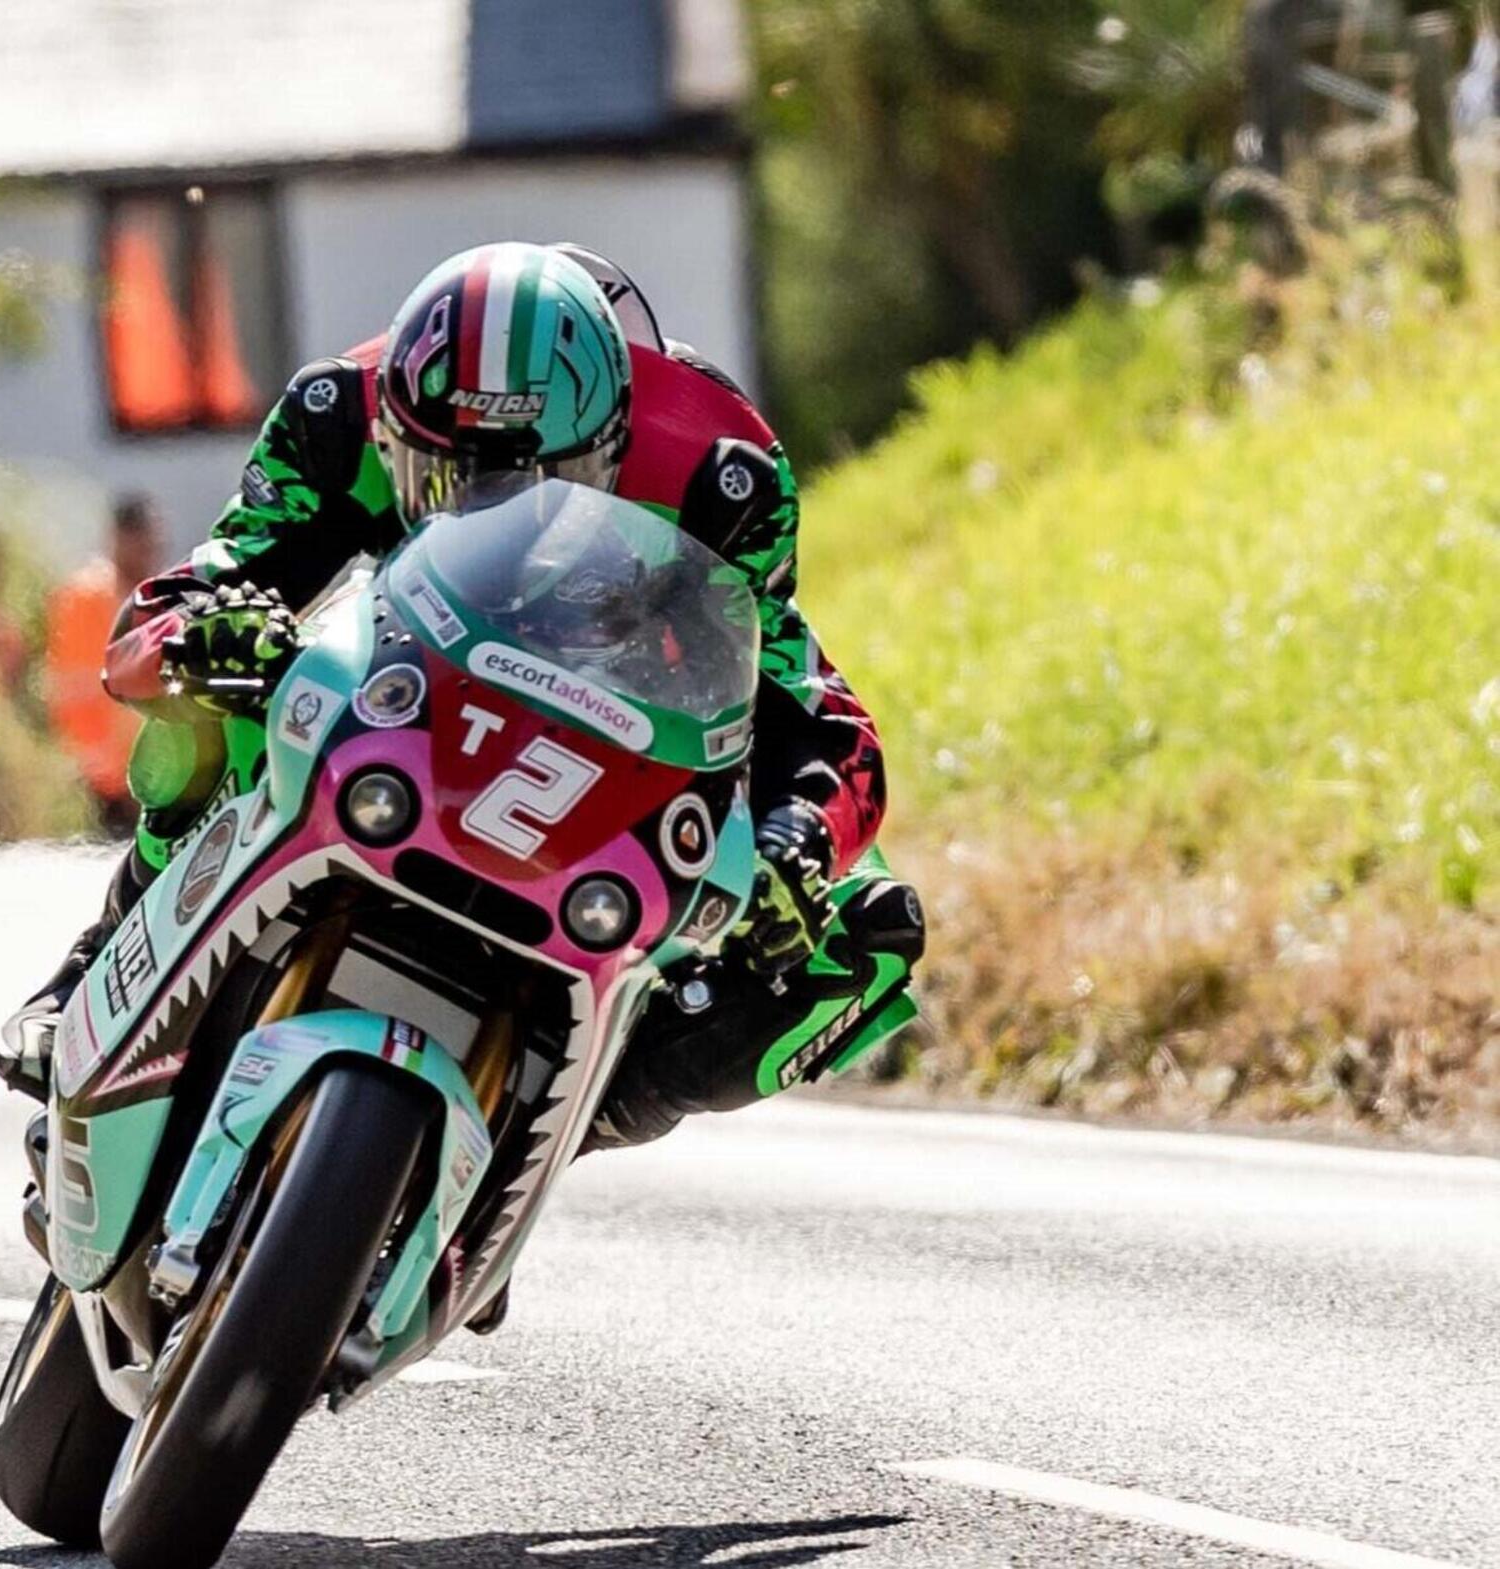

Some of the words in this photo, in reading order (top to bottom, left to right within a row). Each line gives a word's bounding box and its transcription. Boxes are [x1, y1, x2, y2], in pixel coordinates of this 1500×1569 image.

[447, 388, 547, 418] NOLAN
[484, 652, 638, 735] escortadvisor
[459, 703, 507, 757] T
[459, 735, 606, 861] 2
